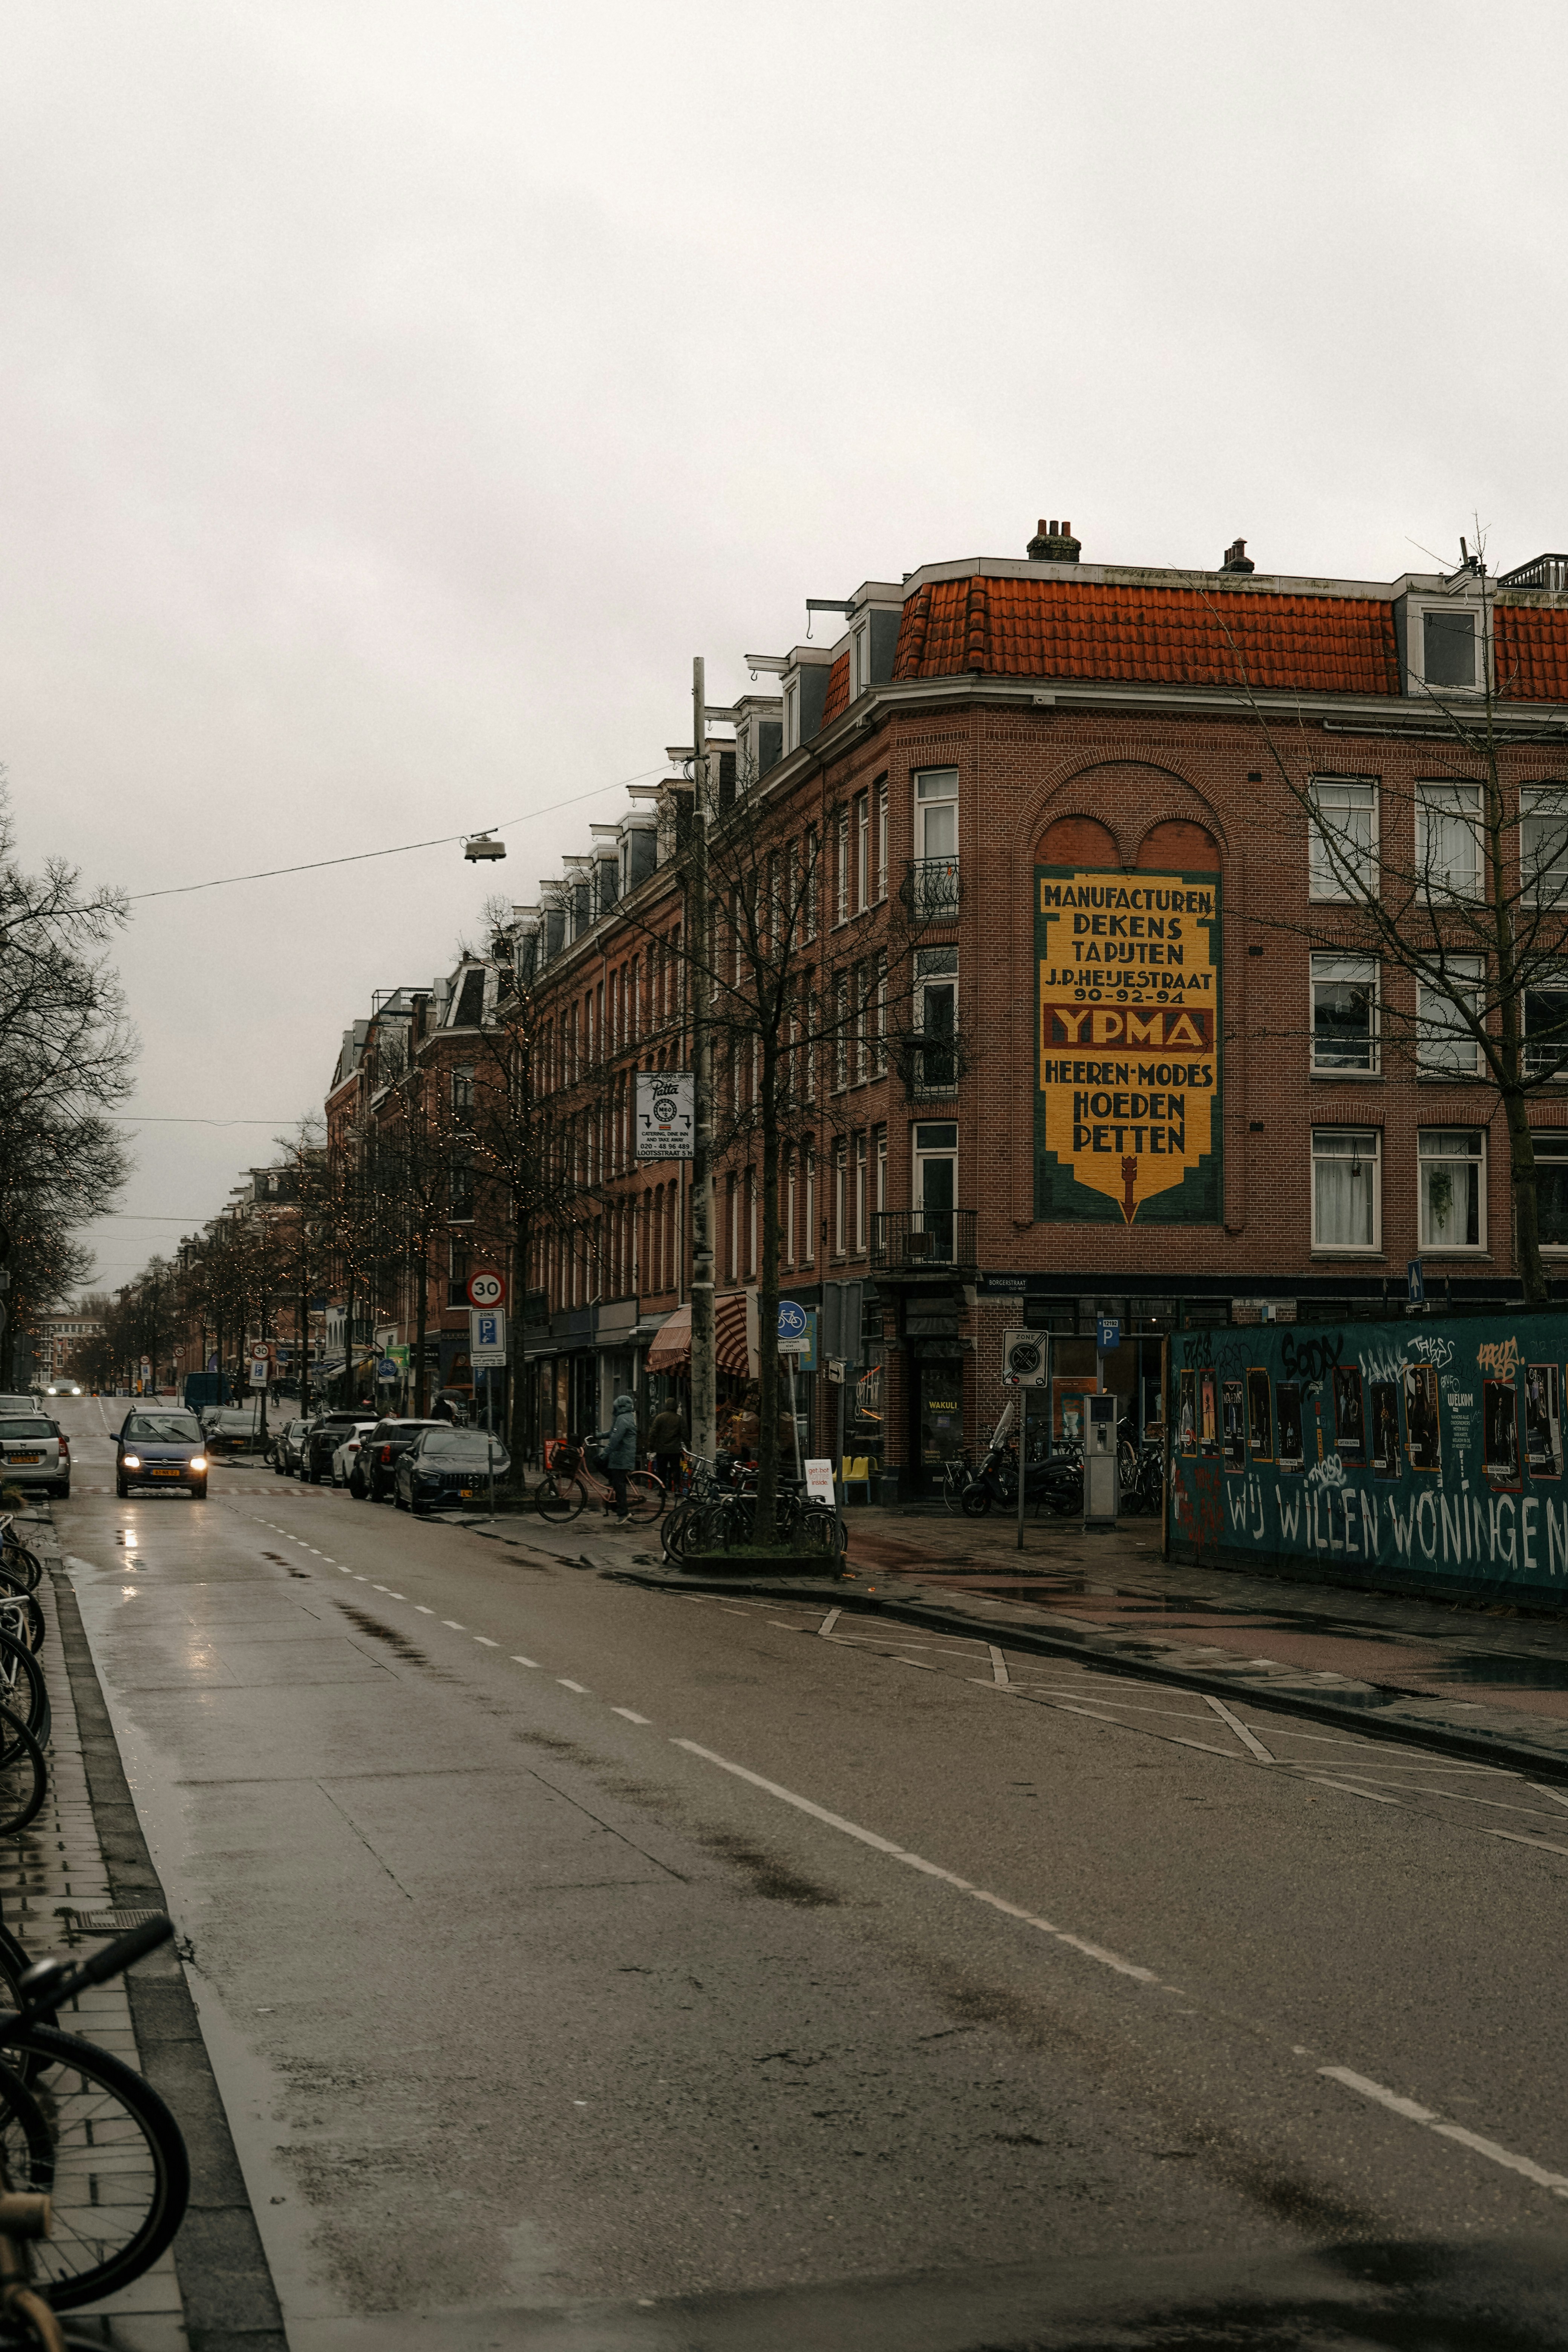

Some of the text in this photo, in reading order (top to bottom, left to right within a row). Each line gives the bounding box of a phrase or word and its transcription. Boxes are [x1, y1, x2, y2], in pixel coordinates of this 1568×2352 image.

[1044, 885, 1210, 913] MANUFACTUREN
[1074, 913, 1182, 940] DEKENS
[1072, 941, 1184, 965] TAPIJTEN
[1074, 988, 1185, 1004] 90-92-94
[1054, 1009, 1204, 1046] YPMA
[1045, 1060, 1213, 1087] HEEREN-MODES
[652, 1080, 679, 1100] Patta
[1073, 1092, 1185, 1123] HOEDEN
[1073, 1122, 1185, 1154] PETTEN
[474, 1282, 498, 1295] 30
[1104, 1329, 1113, 1344] P
[1448, 1393, 1473, 1407] WELKOM
